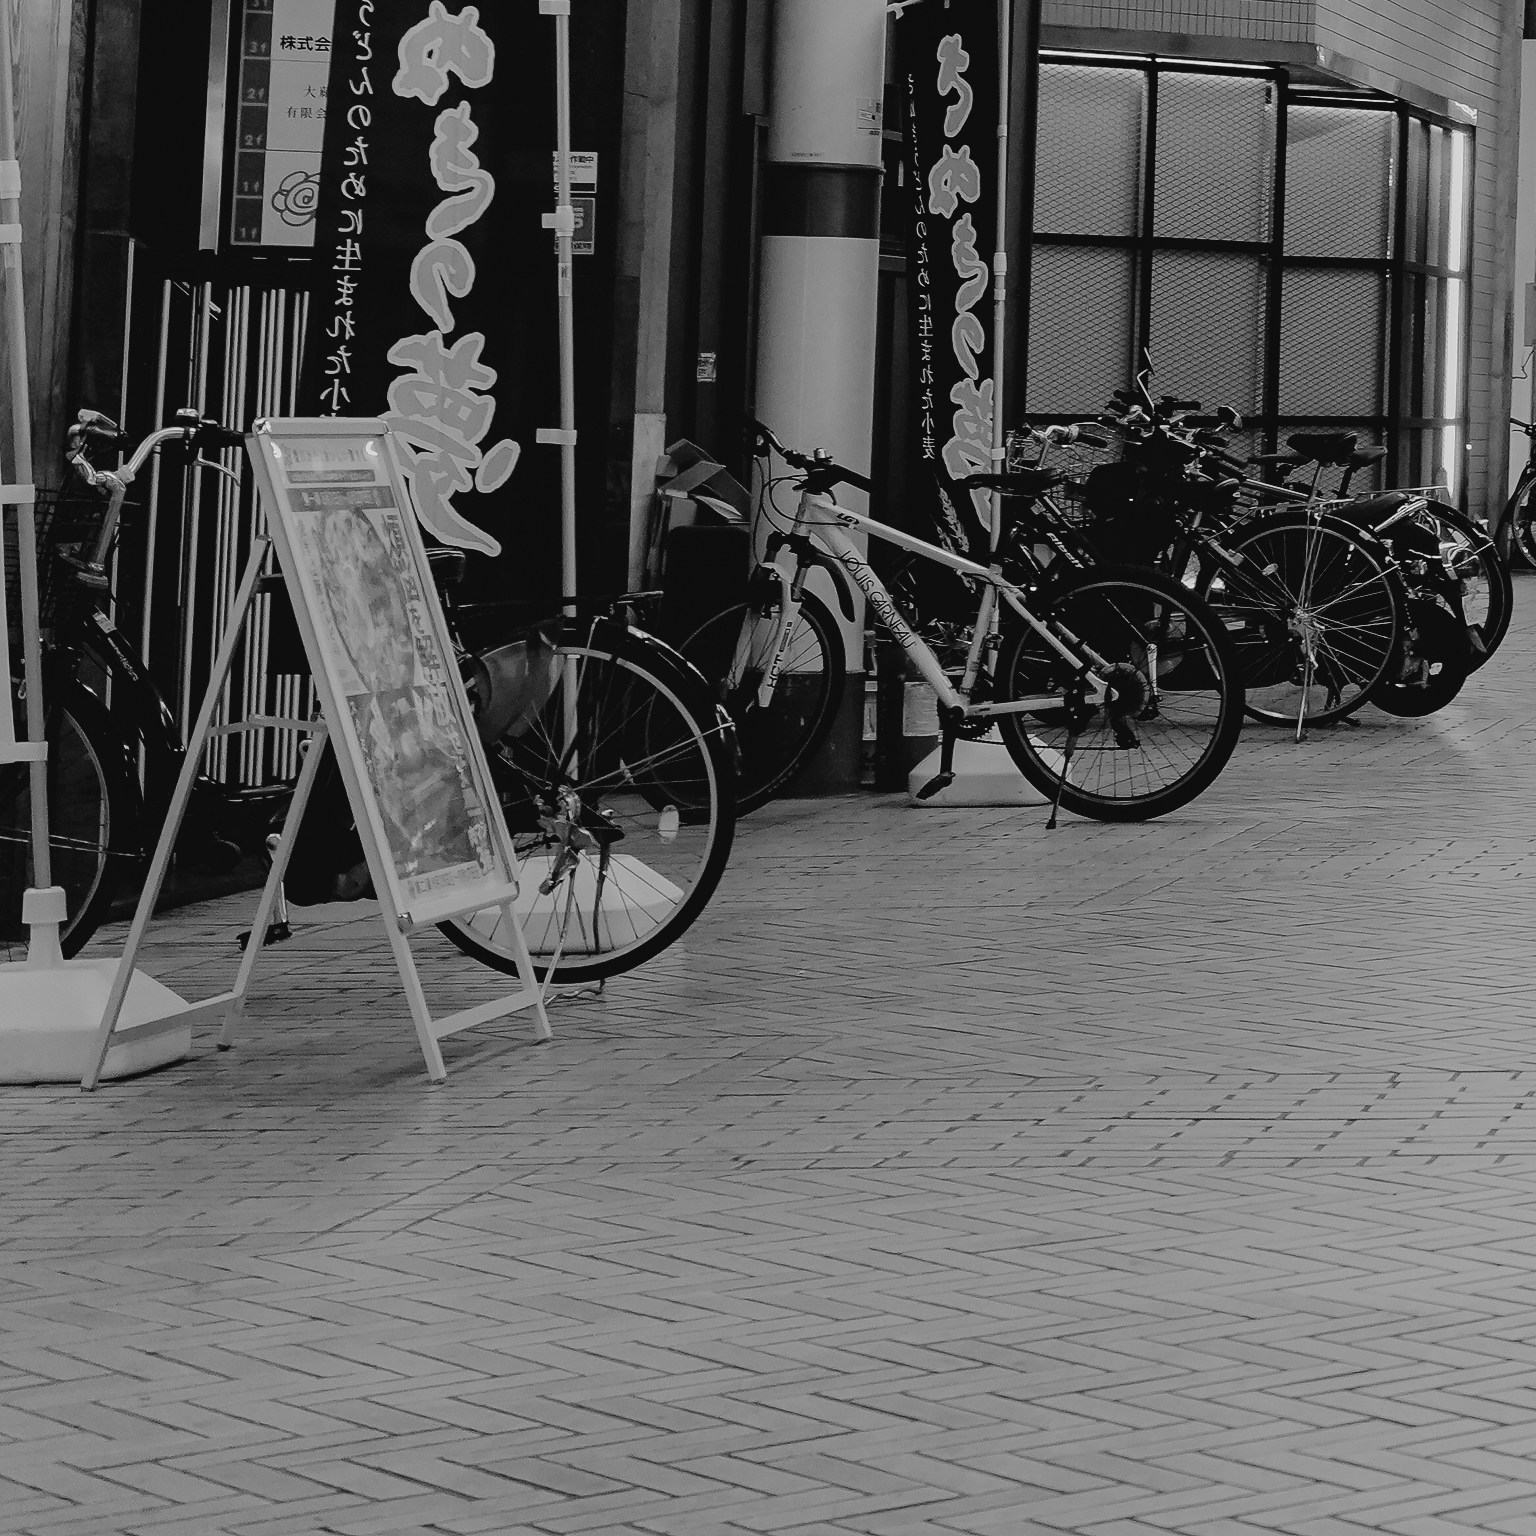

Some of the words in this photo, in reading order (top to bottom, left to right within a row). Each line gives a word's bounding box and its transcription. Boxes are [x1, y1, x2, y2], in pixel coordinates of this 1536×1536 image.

[279, 34, 332, 52] 株式会
[286, 106, 327, 120] 有限会
[840, 549, 874, 594] LOUIS
[869, 591, 914, 651] GARNEAU
